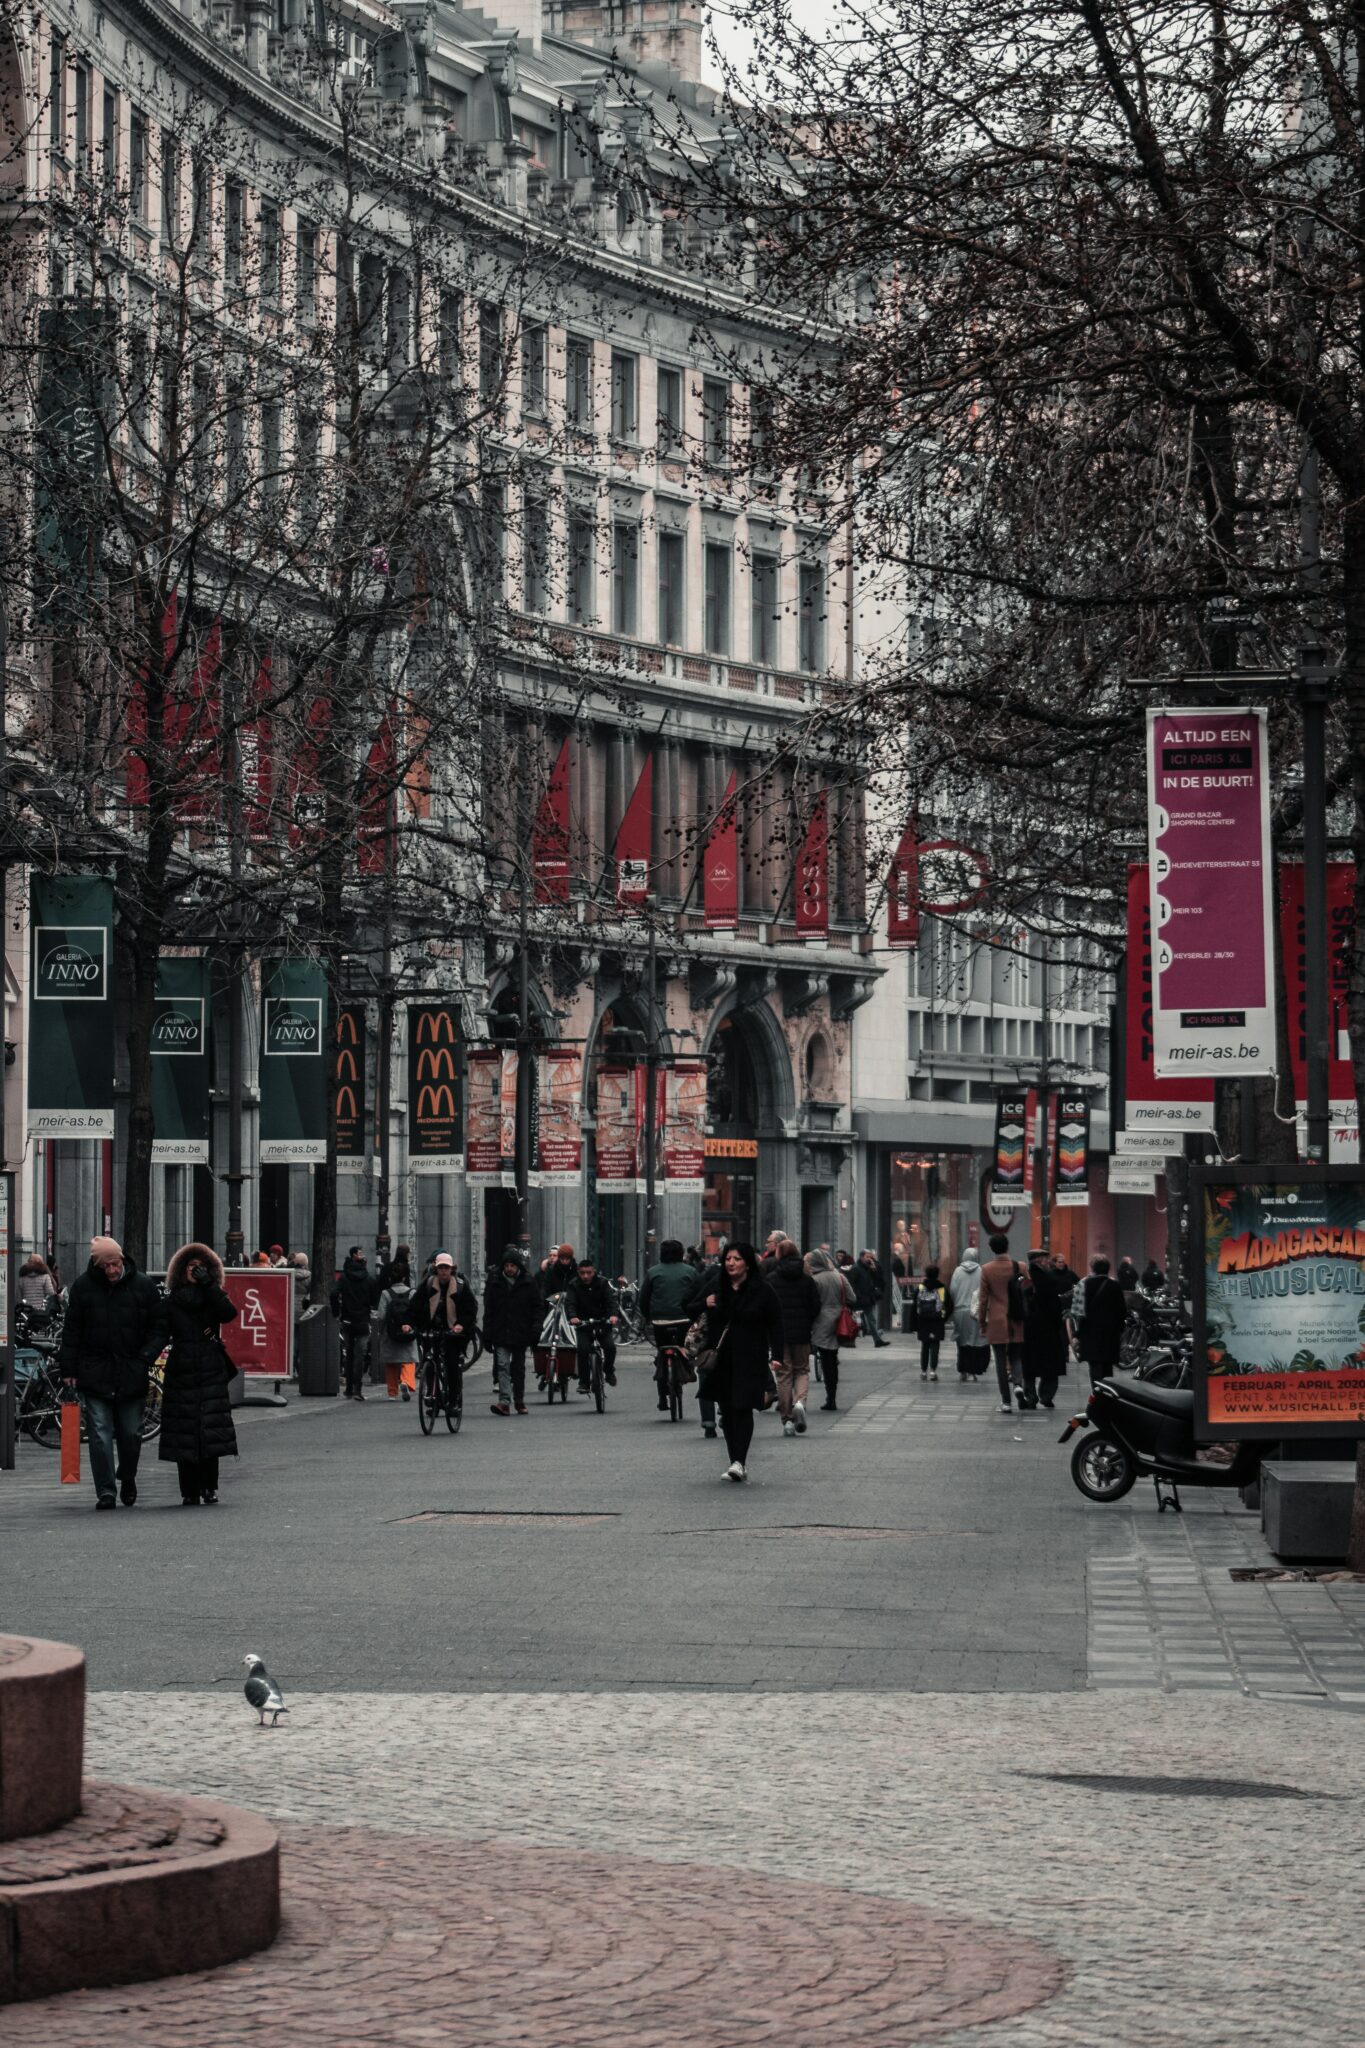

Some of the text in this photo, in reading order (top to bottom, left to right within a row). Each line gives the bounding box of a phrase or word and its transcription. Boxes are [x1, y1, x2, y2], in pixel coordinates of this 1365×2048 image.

[1163, 729, 1251, 743] ALTIJD EEN
[1169, 752, 1244, 765] ICI PARIS XL
[1162, 775, 1254, 789] IN DE BUURT!
[1171, 860, 1260, 869] HUIDEVETTERSSTRAAT 53
[56, 952, 82, 961] GALERIA
[47, 963, 99, 981] INNO
[1186, 1015, 1239, 1025] ICI PARIS XL
[157, 1026, 199, 1040] INNO
[274, 1026, 316, 1040] INNO
[1168, 1043, 1260, 1060] meir-as.be
[1134, 1107, 1203, 1119] meir-as.be
[38, 1114, 104, 1127] meir-as.be
[1124, 1136, 1176, 1146] meir-as.be
[267, 1143, 318, 1154] meir-as.be
[411, 1158, 462, 1167] meir-as.be
[1111, 1159, 1164, 1167] meir-as.be
[1217, 1263, 1365, 1299] THE MUSICAL
[240, 1288, 267, 1346] SALE
[1231, 1329, 1251, 1337] Kevin
[1267, 1329, 1292, 1337] Aguila
[1297, 1328, 1356, 1337] George Noriega
[1223, 1381, 1286, 1391] FEBRUARI
[1297, 1380, 1333, 1389] APRIL
[1337, 1379, 1365, 1389] 2020
[1223, 1391, 1365, 1403] GENT & ANTWERPEN
[1224, 1402, 1365, 1413] WWW.MUSICHALL.BE
